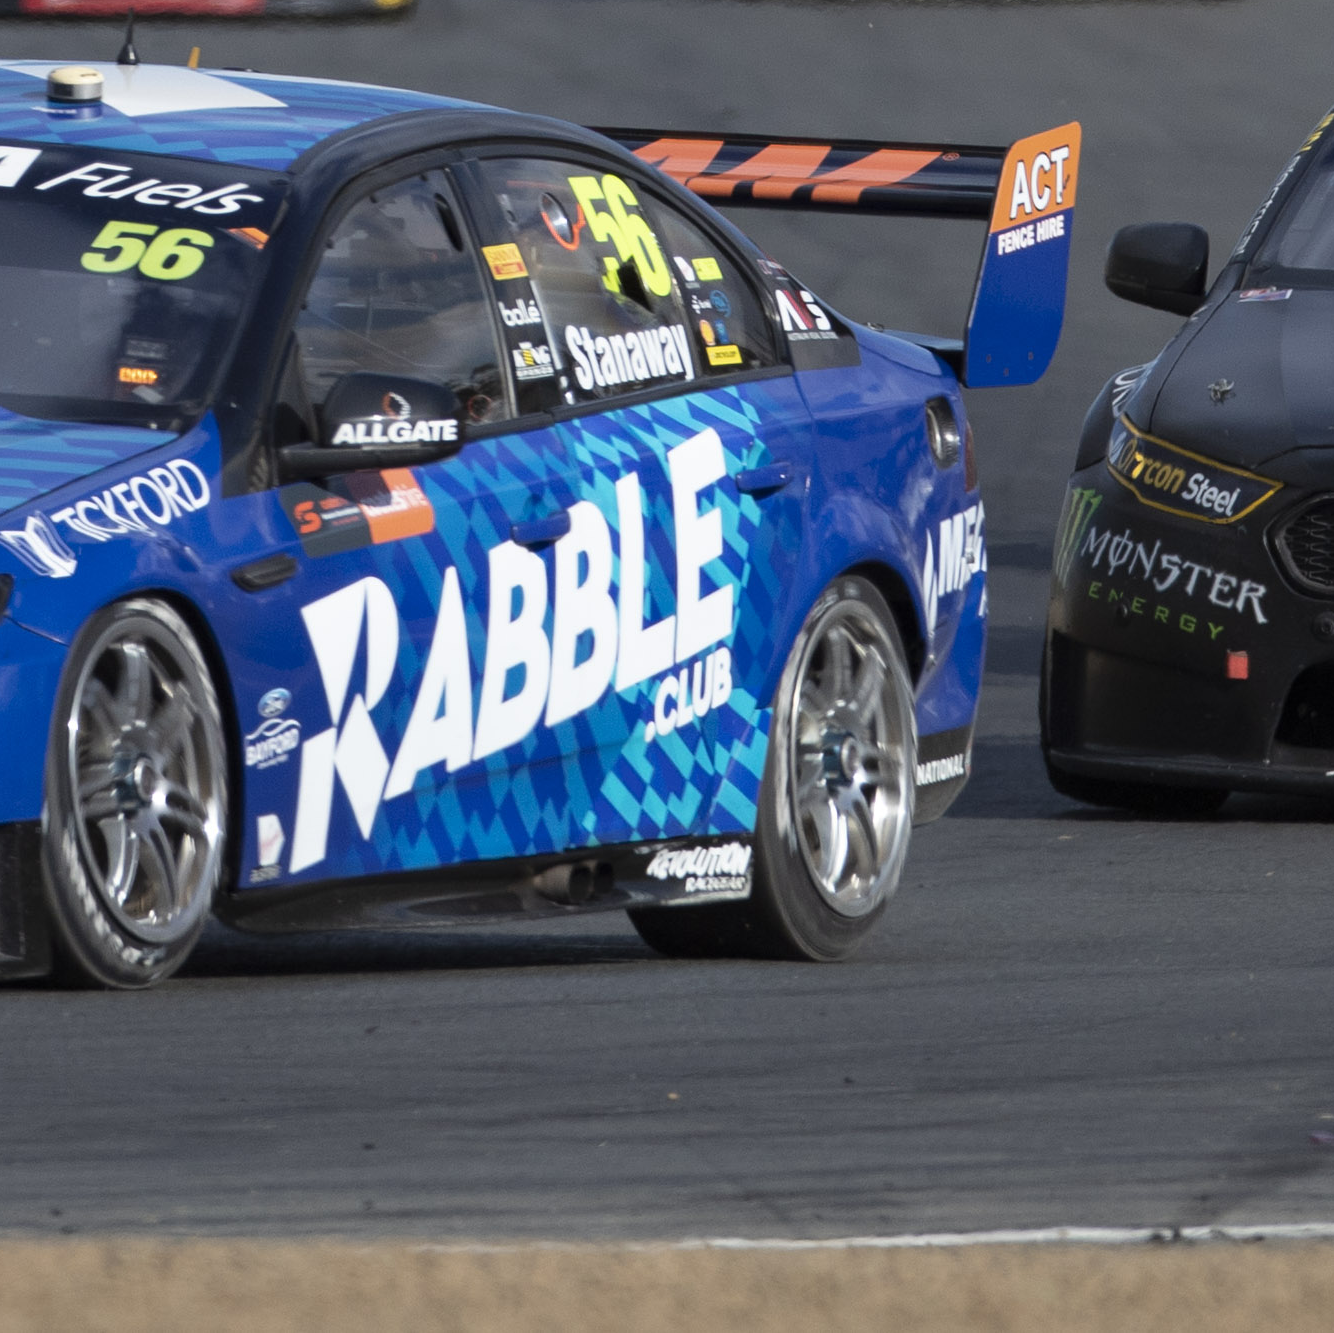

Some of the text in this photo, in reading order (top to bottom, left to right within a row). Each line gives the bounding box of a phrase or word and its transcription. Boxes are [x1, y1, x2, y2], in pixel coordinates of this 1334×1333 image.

[35, 162, 264, 215] Fuels
[1009, 144, 1070, 221] ACT
[80, 220, 215, 281] 56
[567, 173, 672, 297] 56
[997, 214, 1066, 256] FENCE HIRE
[564, 323, 695, 391] Stanaway
[331, 418, 459, 445] ALLGATE
[50, 457, 212, 542] TICKFORD
[1181, 472, 1241, 517] Steel
[1079, 526, 1268, 624] MONSTER
[1088, 581, 1225, 641] ENERGY
[288, 426, 735, 875] RABBLE
[645, 841, 752, 880] REVOLUTION
